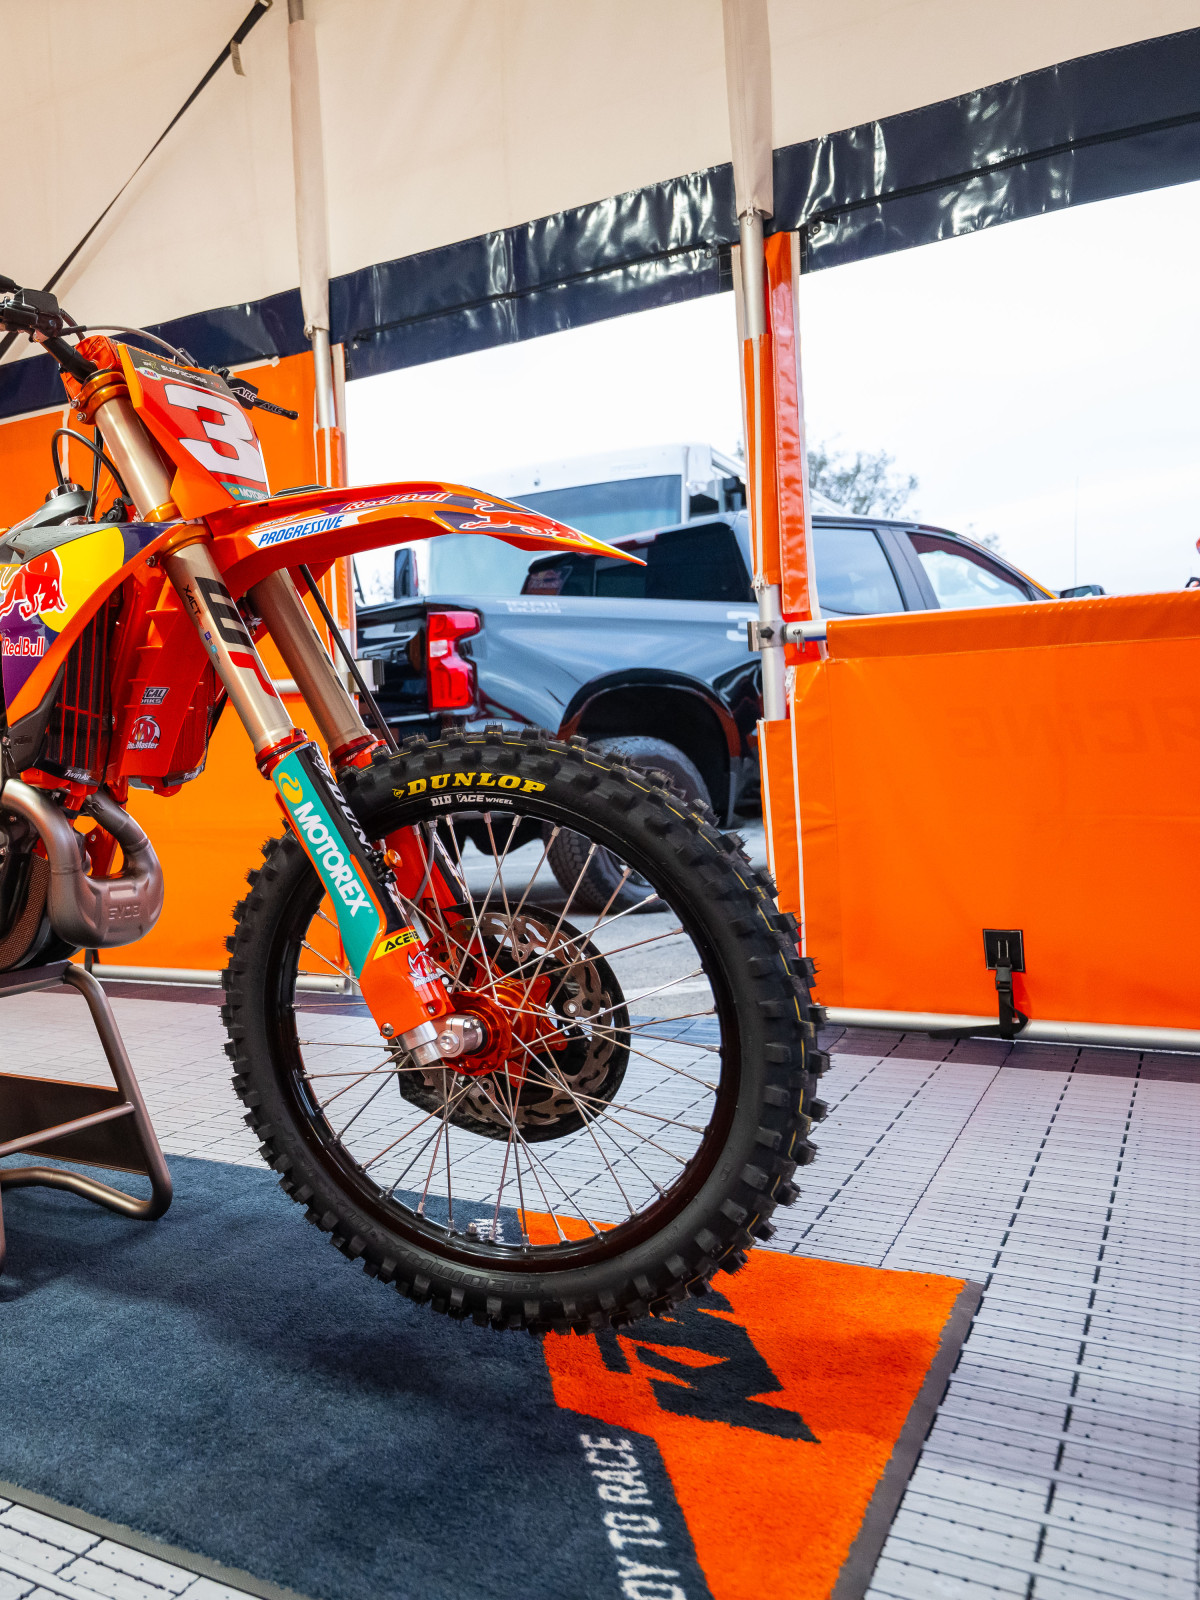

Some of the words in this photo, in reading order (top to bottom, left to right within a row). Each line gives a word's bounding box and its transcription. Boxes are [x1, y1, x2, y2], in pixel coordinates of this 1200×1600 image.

[231, 387, 257, 403] ARC
[164, 383, 267, 484] 3
[339, 496, 398, 514] Red
[398, 492, 453, 503] Bull
[257, 514, 345, 547] PROGRESSIVE
[182, 584, 202, 616] XACT
[3, 637, 21, 656] Red
[22, 636, 45, 657] Bull
[407, 772, 546, 796] DUNLOP
[431, 795, 452, 807] DID
[485, 797, 514, 806] WHEEL
[294, 801, 371, 918] MOTOREX
[579, 1434, 653, 1505] RACE
[602, 1511, 669, 1549] TO
